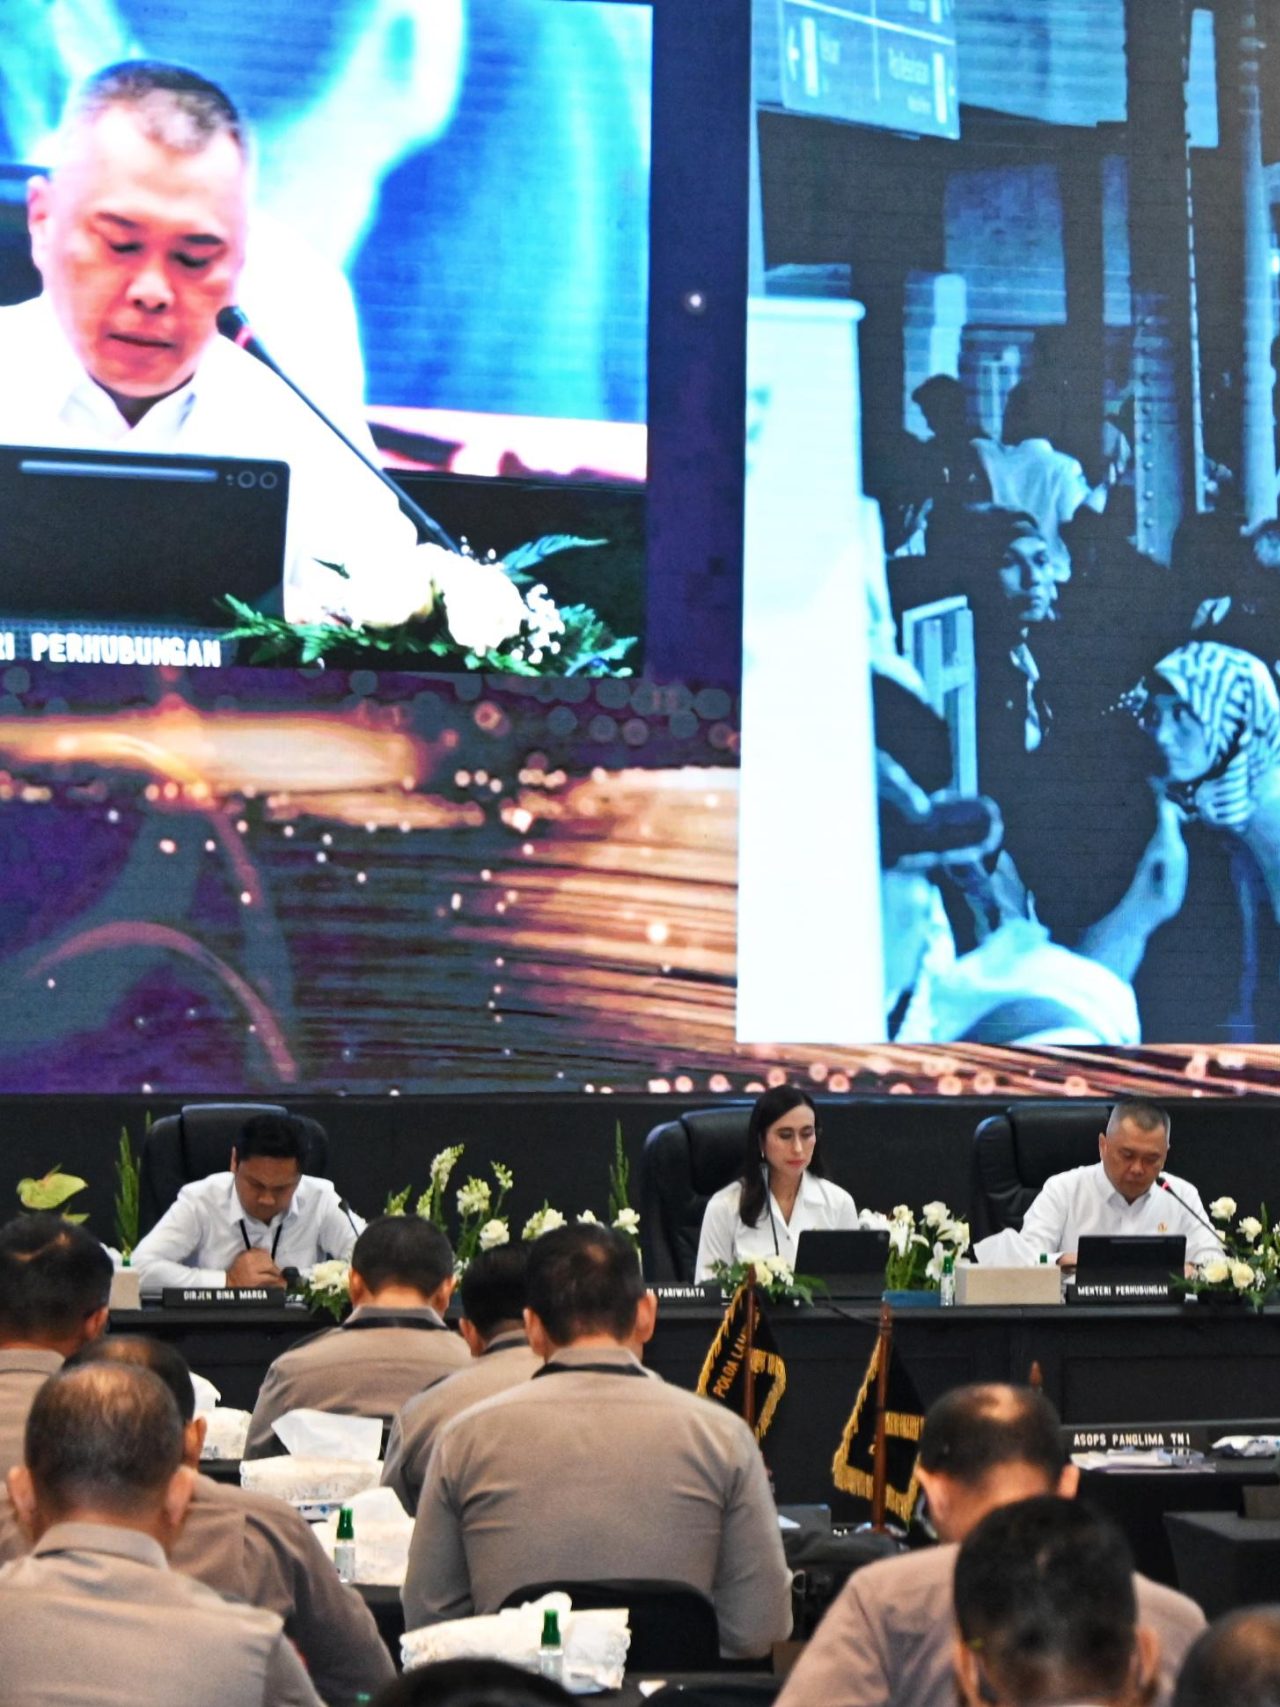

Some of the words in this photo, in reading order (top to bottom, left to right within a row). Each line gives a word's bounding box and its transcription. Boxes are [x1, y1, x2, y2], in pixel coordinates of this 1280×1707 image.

[31, 633, 222, 668] PERHUBUNGAN
[239, 1289, 268, 1300] MARGA
[658, 1287, 706, 1298] PARIWISATA
[1077, 1285, 1112, 1296] MENTERI
[1115, 1284, 1169, 1296] PERHUBUNGAN
[1073, 1433, 1107, 1446] ASOPS
[1112, 1433, 1164, 1446] PANGLIMA
[1170, 1433, 1191, 1446] TNI
